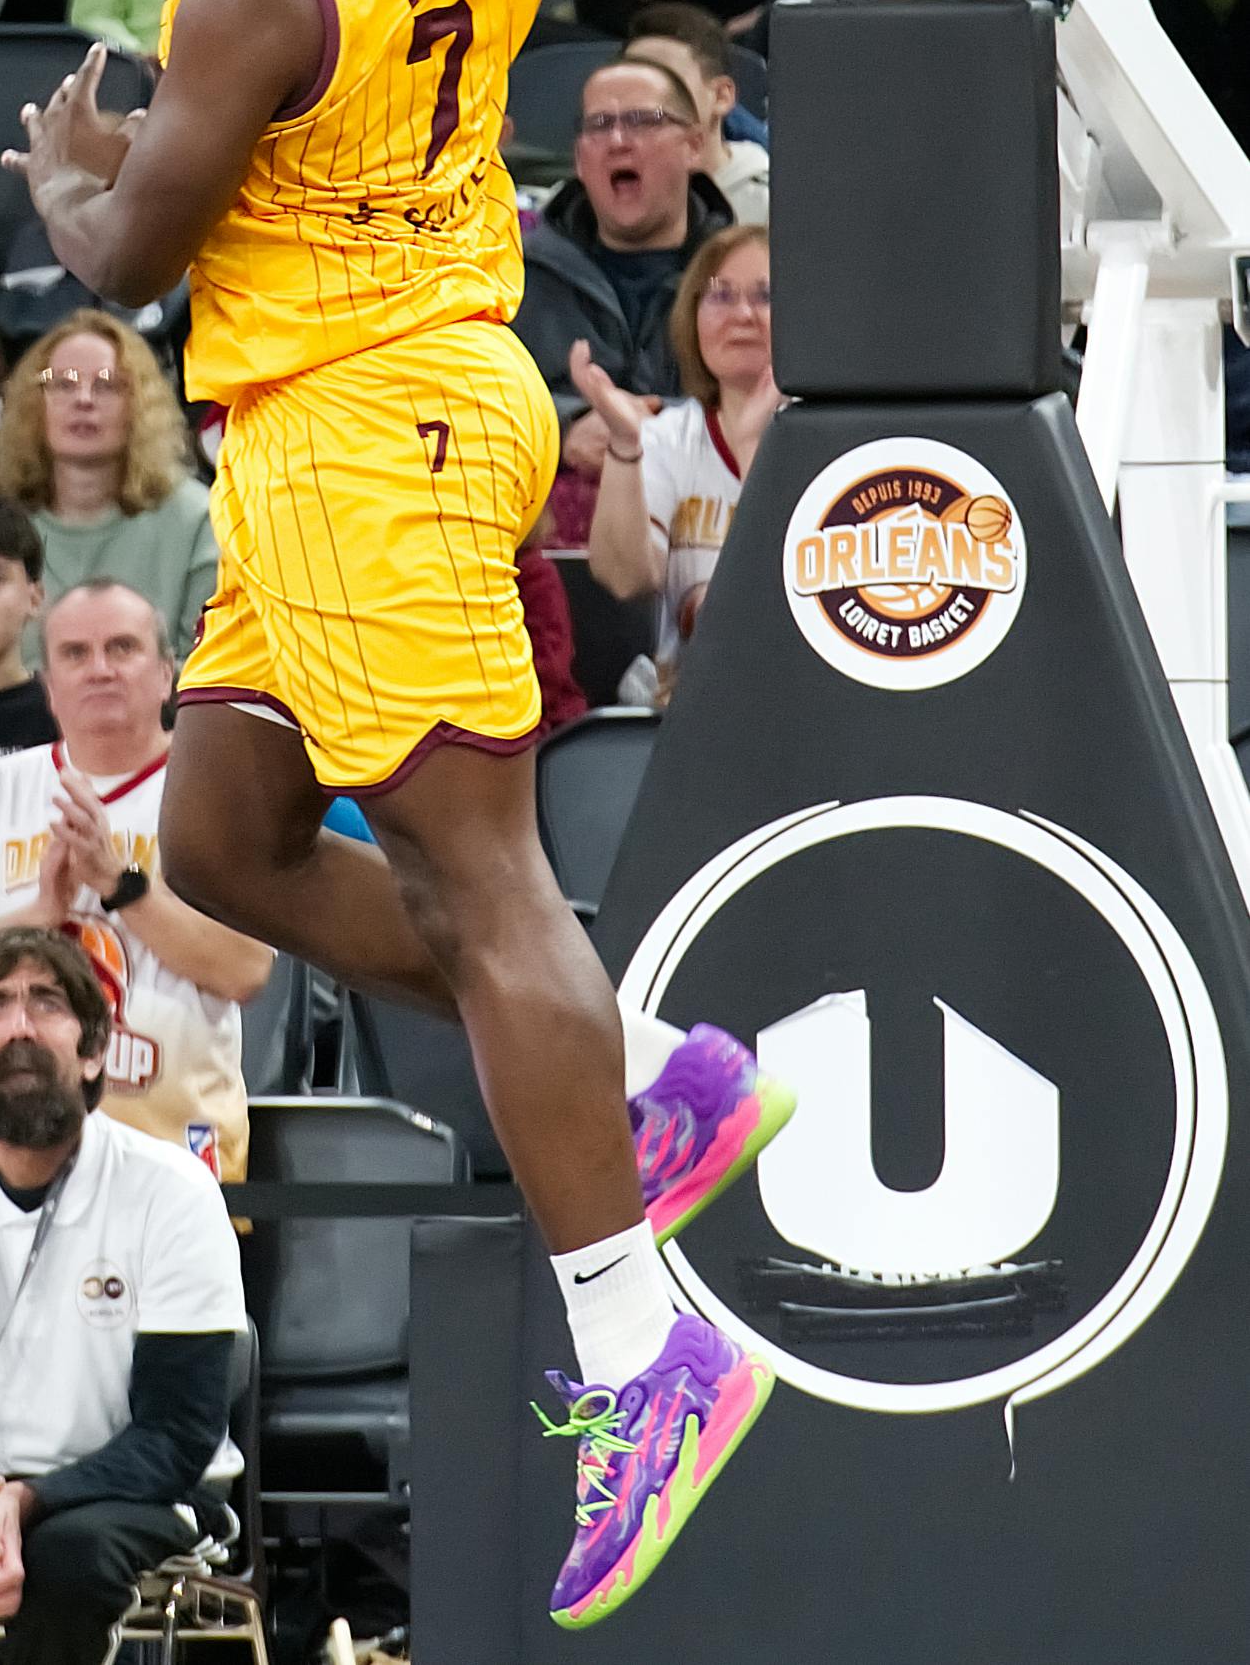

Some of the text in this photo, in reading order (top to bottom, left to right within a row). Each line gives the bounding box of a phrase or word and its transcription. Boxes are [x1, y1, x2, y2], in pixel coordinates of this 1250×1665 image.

[415, 419, 450, 474] 7
[851, 479, 942, 515] DEPUIS 1993
[837, 592, 975, 649] LOIRET BASKET
[756, 988, 1061, 1269] U
